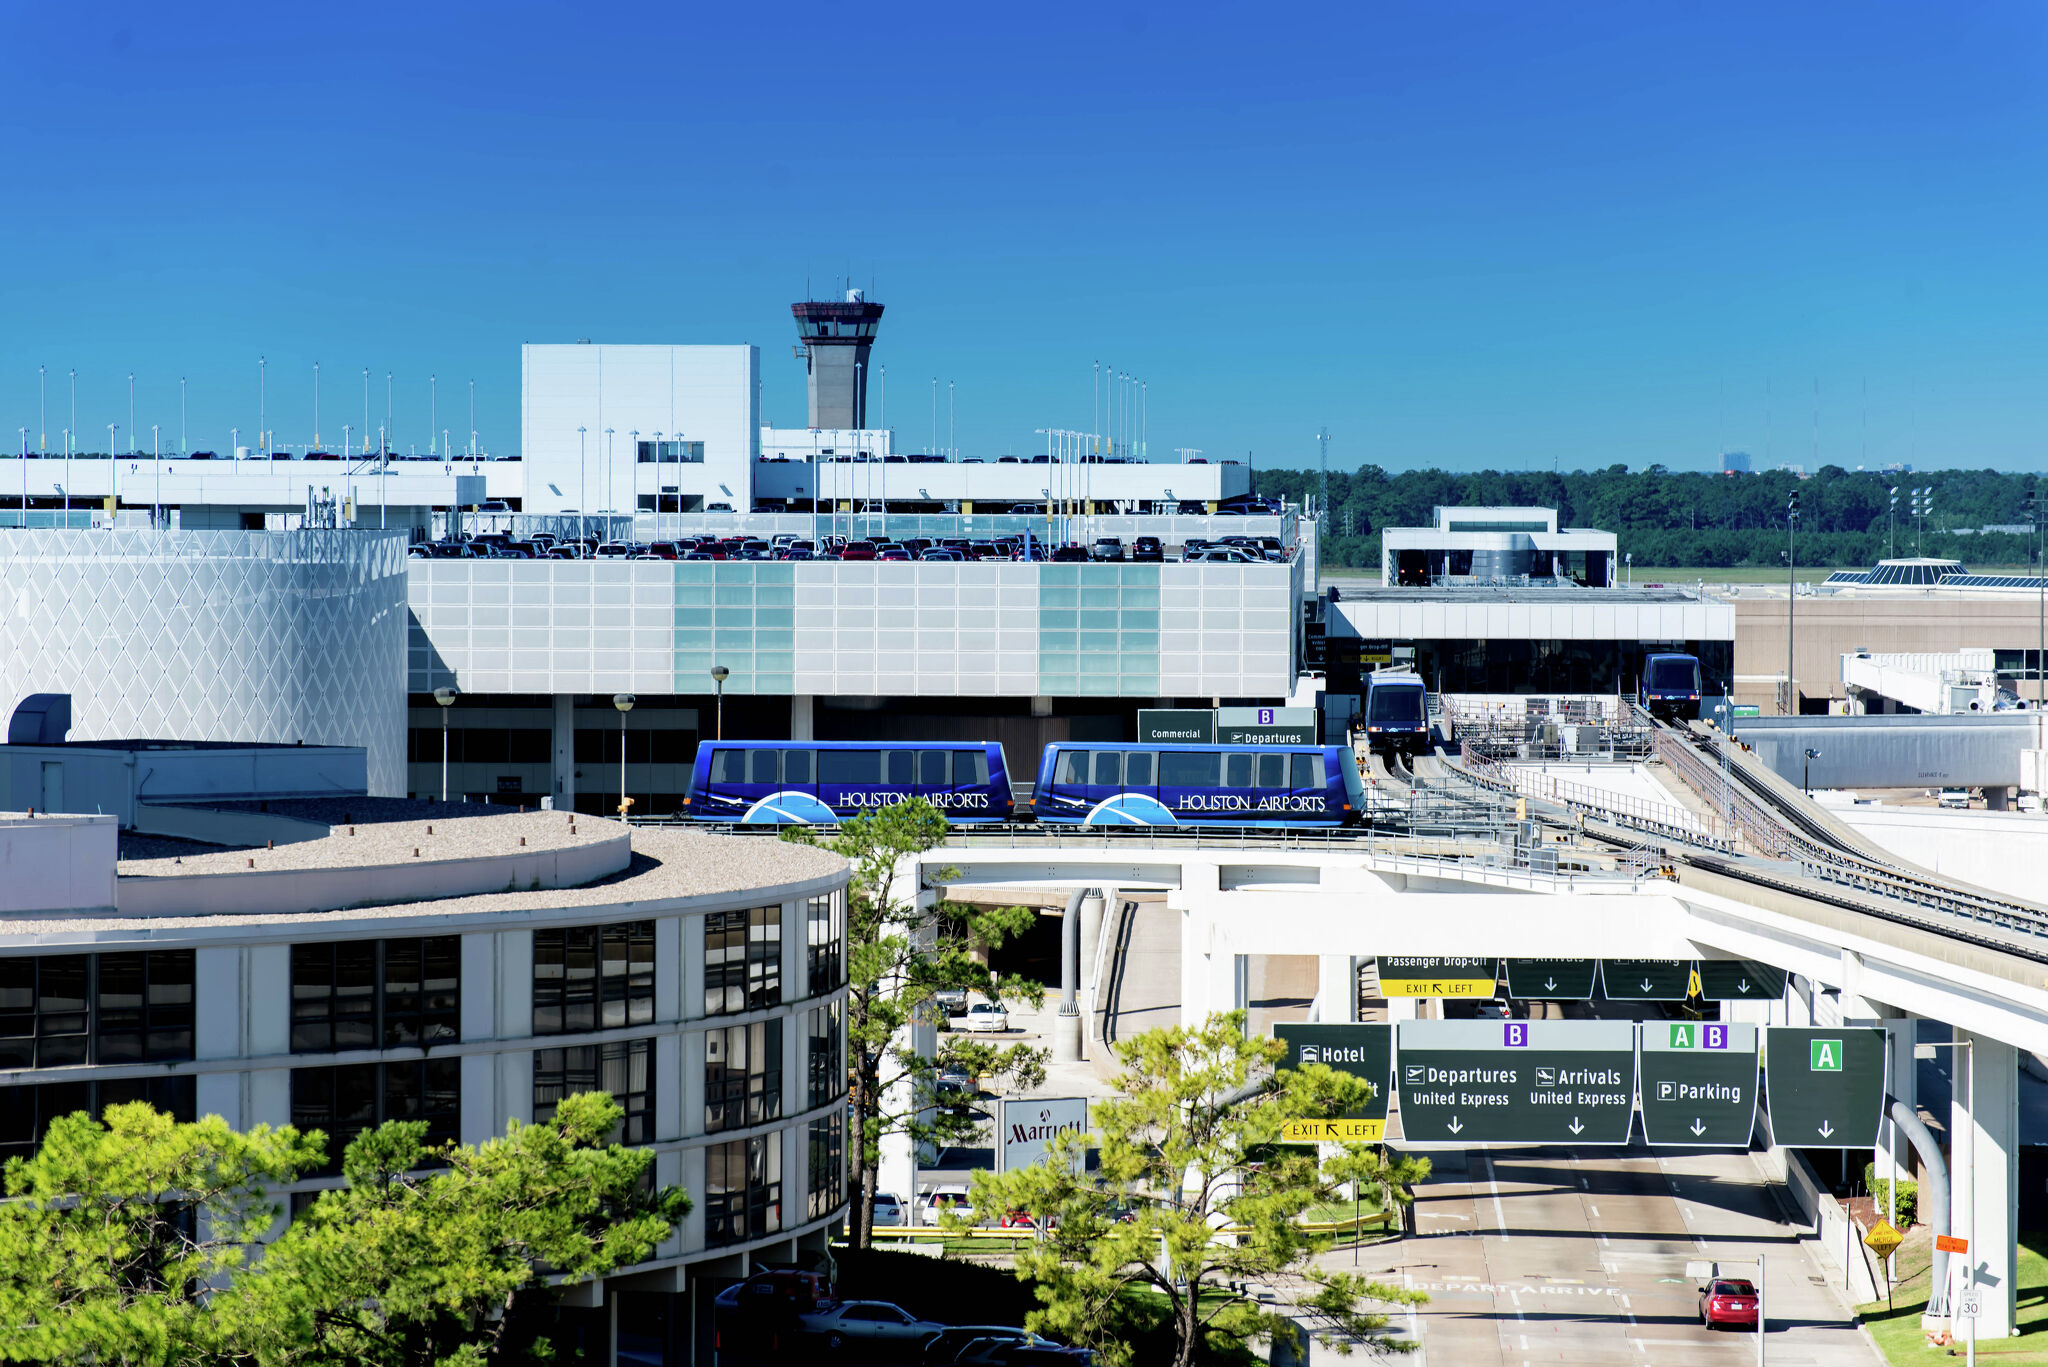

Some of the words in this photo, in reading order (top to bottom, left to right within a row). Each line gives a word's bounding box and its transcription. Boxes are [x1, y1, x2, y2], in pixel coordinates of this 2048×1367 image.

[1261, 710, 1270, 724] B
[1151, 729, 1200, 738] Commercial
[1245, 733, 1301, 744] Departures
[840, 792, 911, 807] HOUSTON
[923, 793, 988, 808] AIRPORTS
[1179, 794, 1251, 810] HOUSTON
[1257, 795, 1325, 812] AIRPORTS
[1387, 956, 1440, 969] Passenger
[1406, 983, 1428, 993] EXIT
[1448, 984, 1473, 993] LEFT
[1510, 1025, 1522, 1045] B
[1674, 1026, 1689, 1047] A
[1709, 1026, 1722, 1047] B
[1323, 1047, 1365, 1063] Hotel
[1817, 1043, 1835, 1068] A
[1428, 1067, 1517, 1086] Departures
[1558, 1069, 1621, 1085] Arrivals
[1413, 1091, 1456, 1106] United
[1461, 1092, 1509, 1108] Express
[1530, 1091, 1572, 1105] United
[1577, 1091, 1626, 1108] Express
[1679, 1083, 1741, 1104] Parking
[1293, 1124, 1319, 1135] EXIT
[1346, 1125, 1377, 1136] LEFT
[1877, 1243, 1892, 1251] LEFT
[1413, 1282, 1509, 1294] DEPART
[1519, 1285, 1623, 1297] ARRIVE
[1963, 1302, 1979, 1314] 30
